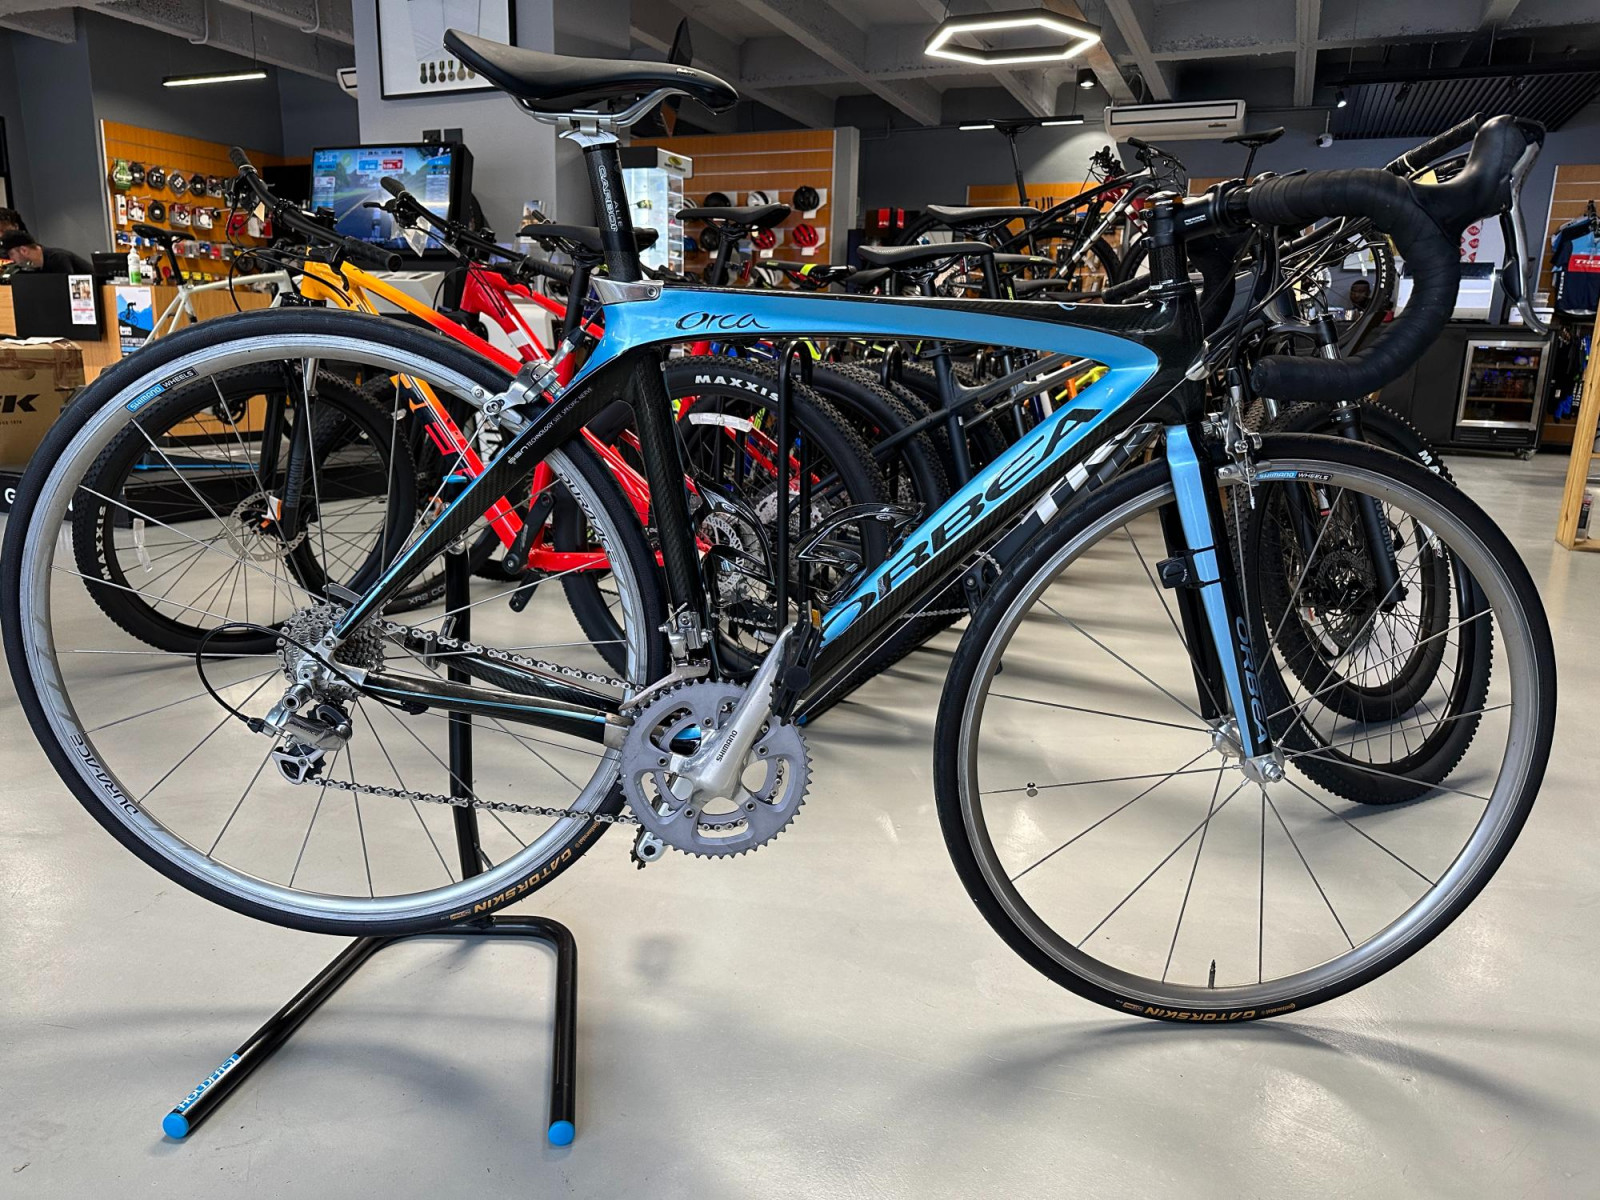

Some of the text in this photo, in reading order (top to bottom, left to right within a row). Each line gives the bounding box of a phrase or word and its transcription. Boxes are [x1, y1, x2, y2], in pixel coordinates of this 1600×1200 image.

[676, 310, 770, 330] Orca
[129, 370, 194, 410] SHIMANO WHEELS
[694, 375, 779, 402] MAXXIS
[527, 420, 555, 448] TECHNOLOGY
[1258, 471, 1330, 481] SHIMANO WHEELS
[95, 505, 113, 580] MAXXIS
[817, 408, 1104, 648] ORBEA
[1235, 616, 1268, 744] ORBEA
[716, 730, 738, 762] SHIMANO
[69, 733, 139, 816] DURA-ACE
[474, 847, 573, 914] GATORSKIN
[1144, 1006, 1256, 1022] GATORSKIN
[178, 1054, 237, 1109] HOLDFAST
